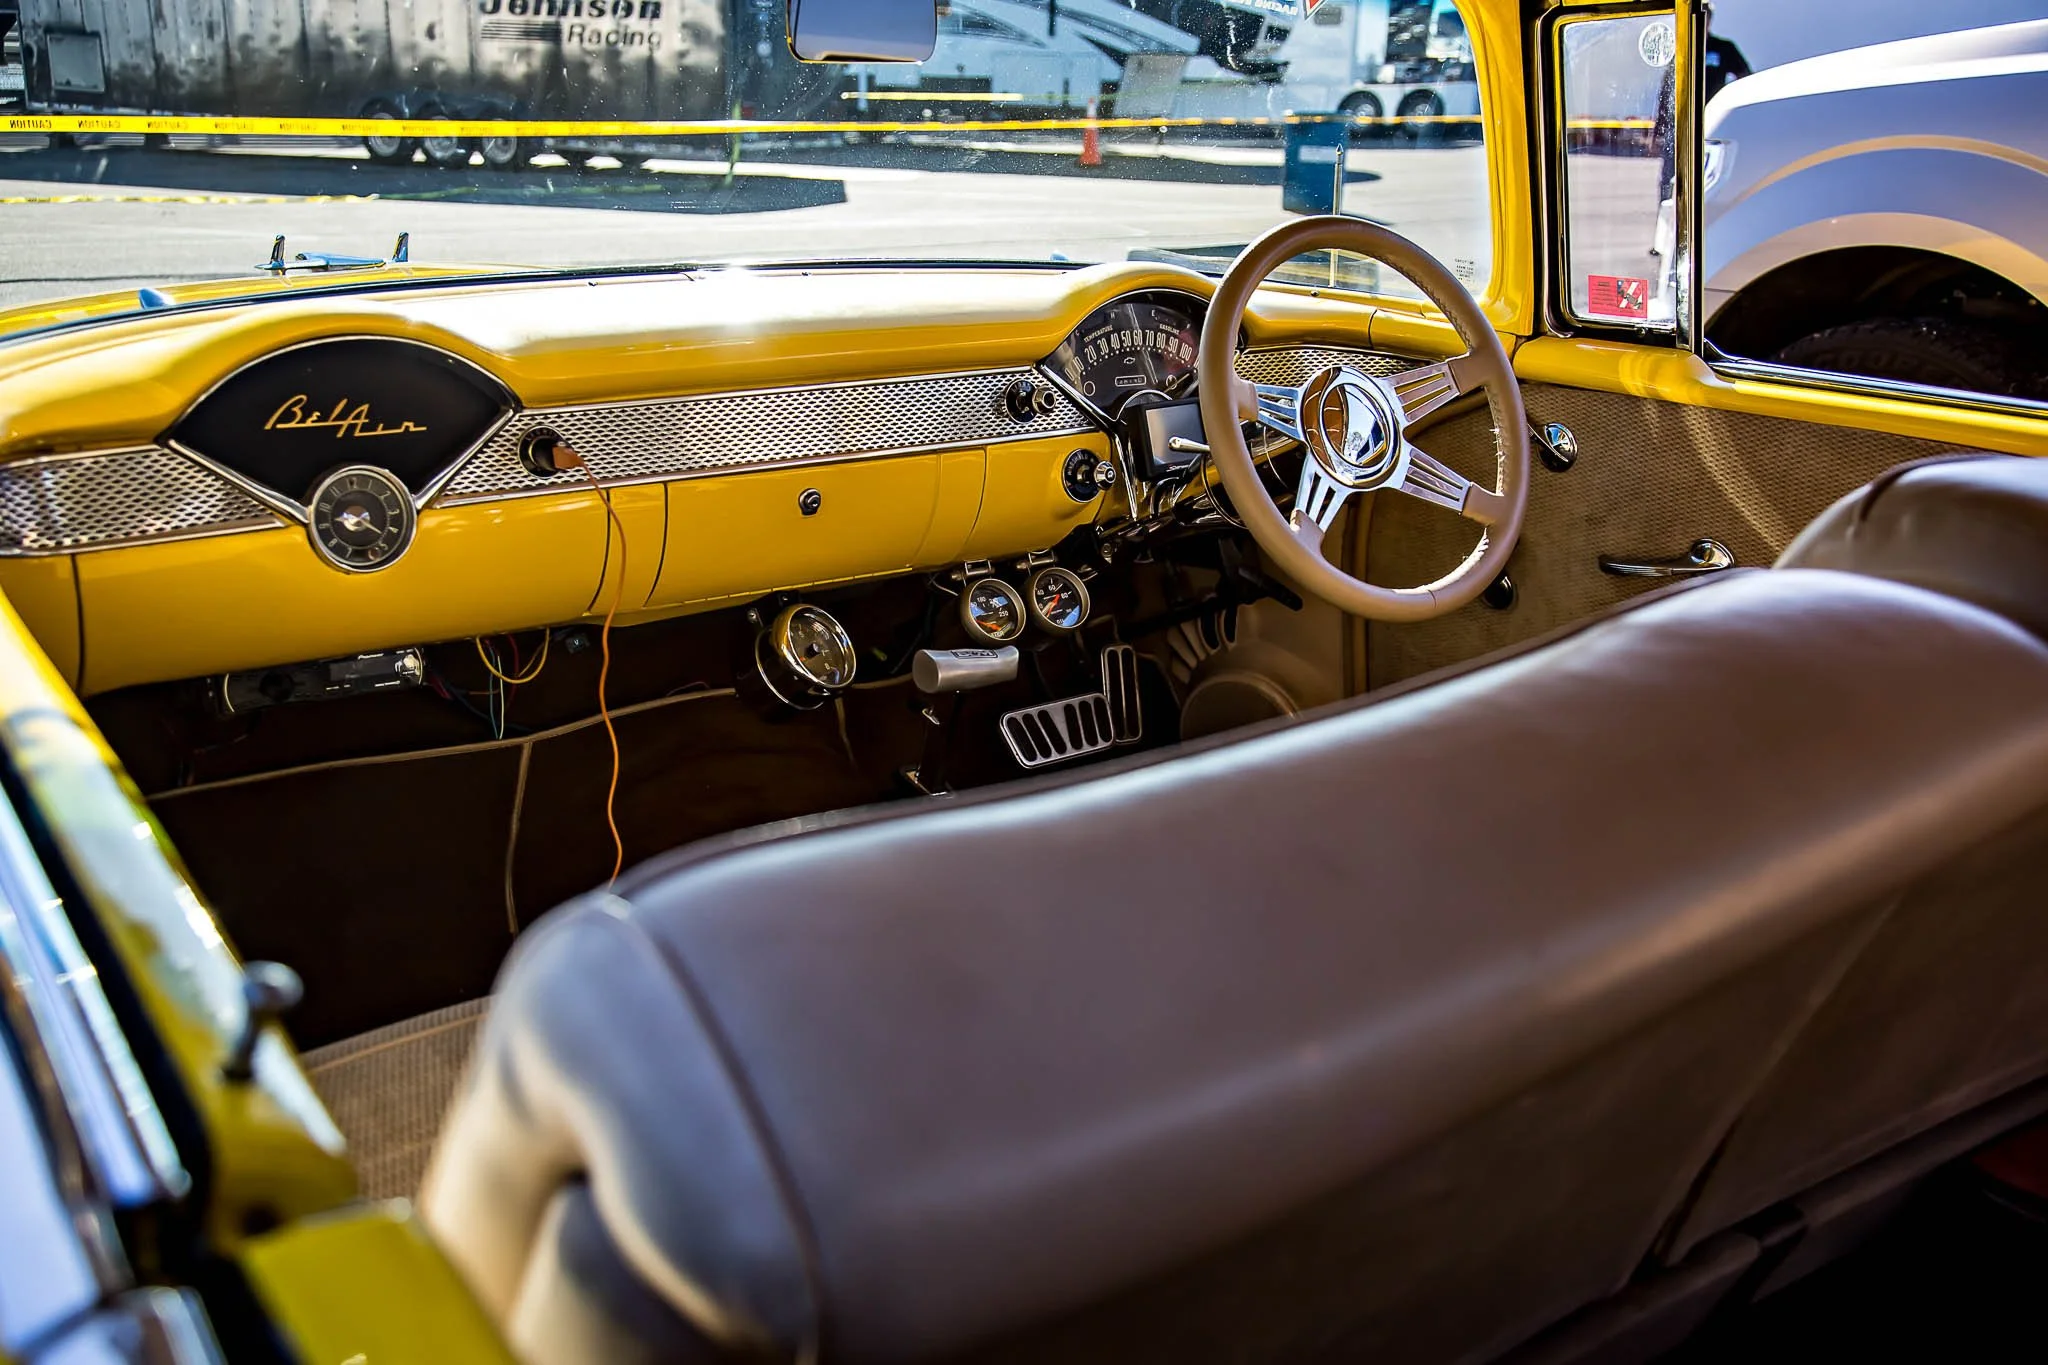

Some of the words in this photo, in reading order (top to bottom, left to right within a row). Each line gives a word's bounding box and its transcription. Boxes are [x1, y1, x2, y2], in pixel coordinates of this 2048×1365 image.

[480, 0, 662, 19] Johnson
[567, 23, 662, 48] Racing
[1072, 356, 1085, 374] 10
[1084, 345, 1098, 364] 20
[1097, 338, 1109, 356] 30
[1110, 332, 1121, 353] 40
[1121, 330, 1132, 347] 50
[1133, 329, 1143, 346] 60
[1145, 329, 1155, 346] 70
[1156, 332, 1166, 349] 80
[1168, 338, 1179, 356] 90
[1179, 342, 1193, 362] 100
[264, 394, 349, 430] Bel
[336, 403, 428, 438] Air
[379, 490, 391, 500] 2
[319, 502, 331, 513] 10
[1048, 584, 1057, 592] 60
